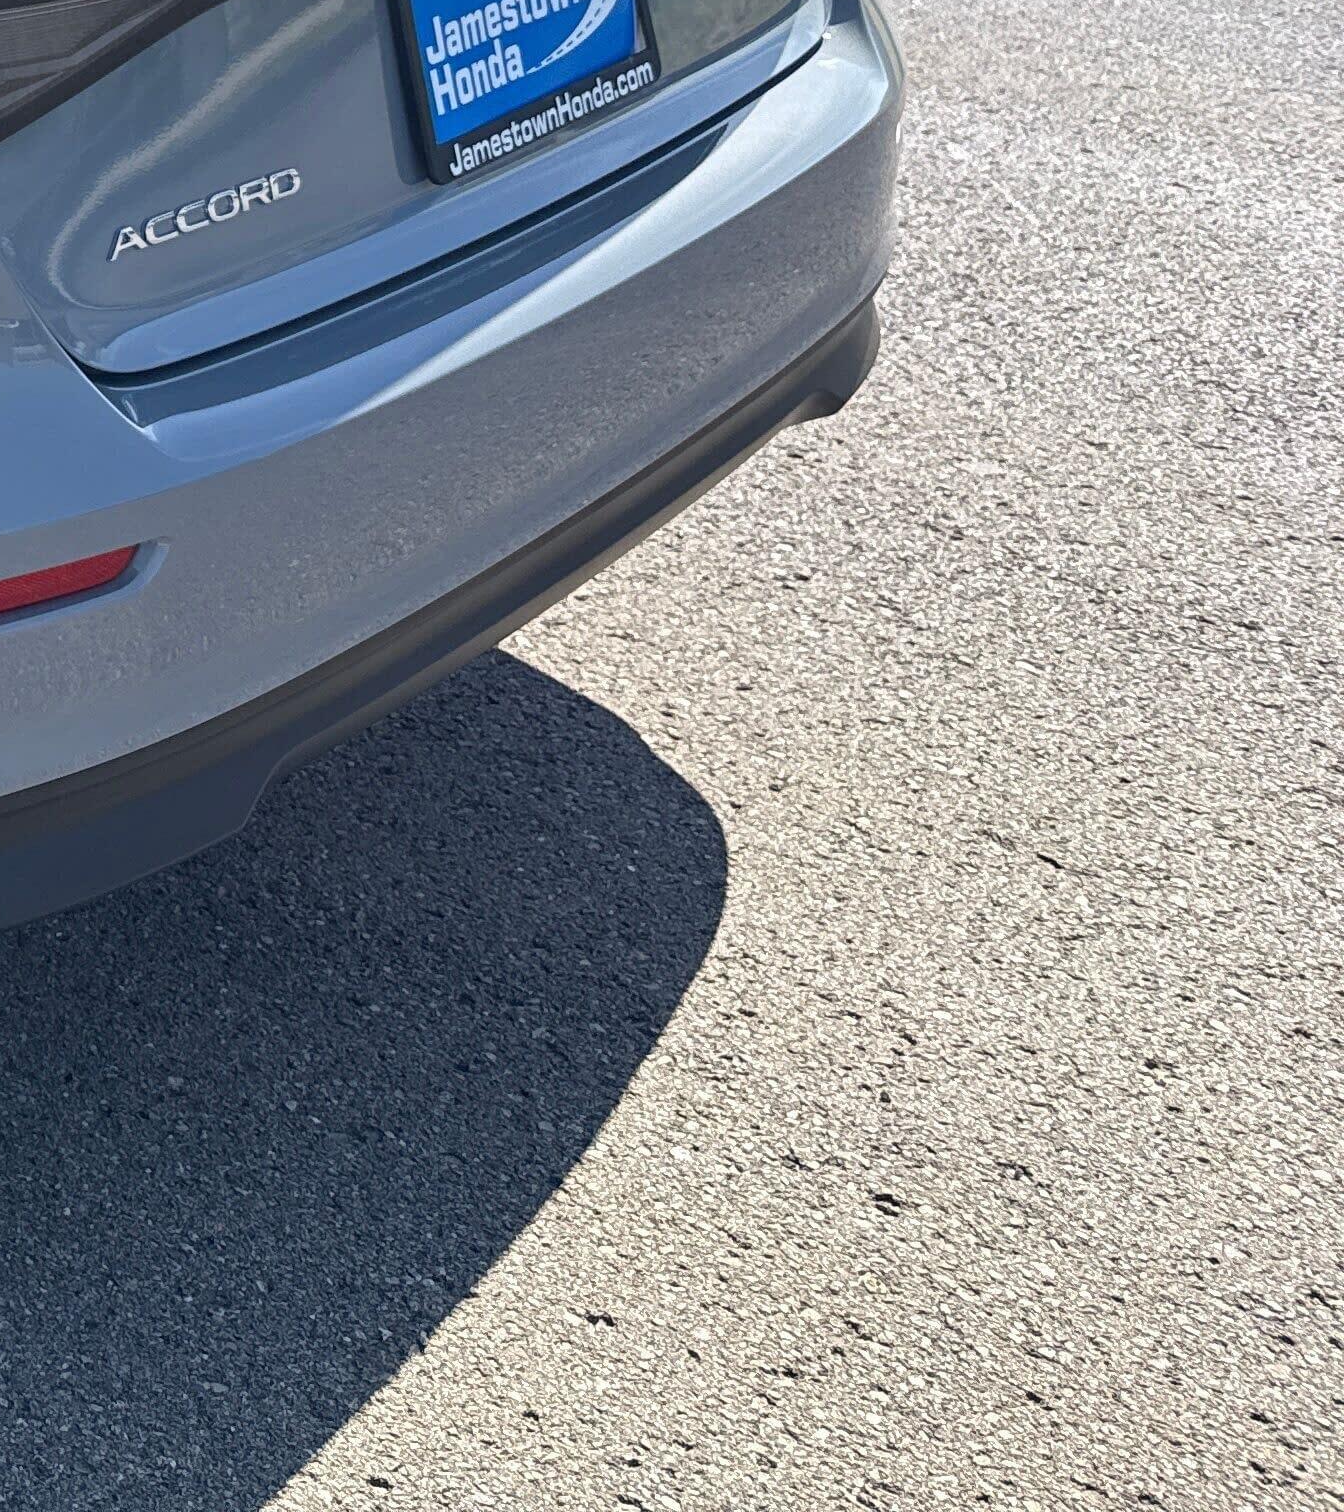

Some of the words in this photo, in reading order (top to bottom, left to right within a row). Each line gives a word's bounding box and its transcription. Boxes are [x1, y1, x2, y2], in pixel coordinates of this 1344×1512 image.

[429, 38, 525, 116] Honda
[449, 61, 654, 177] JamestownHonda.com
[108, 166, 301, 263] ACCORD
